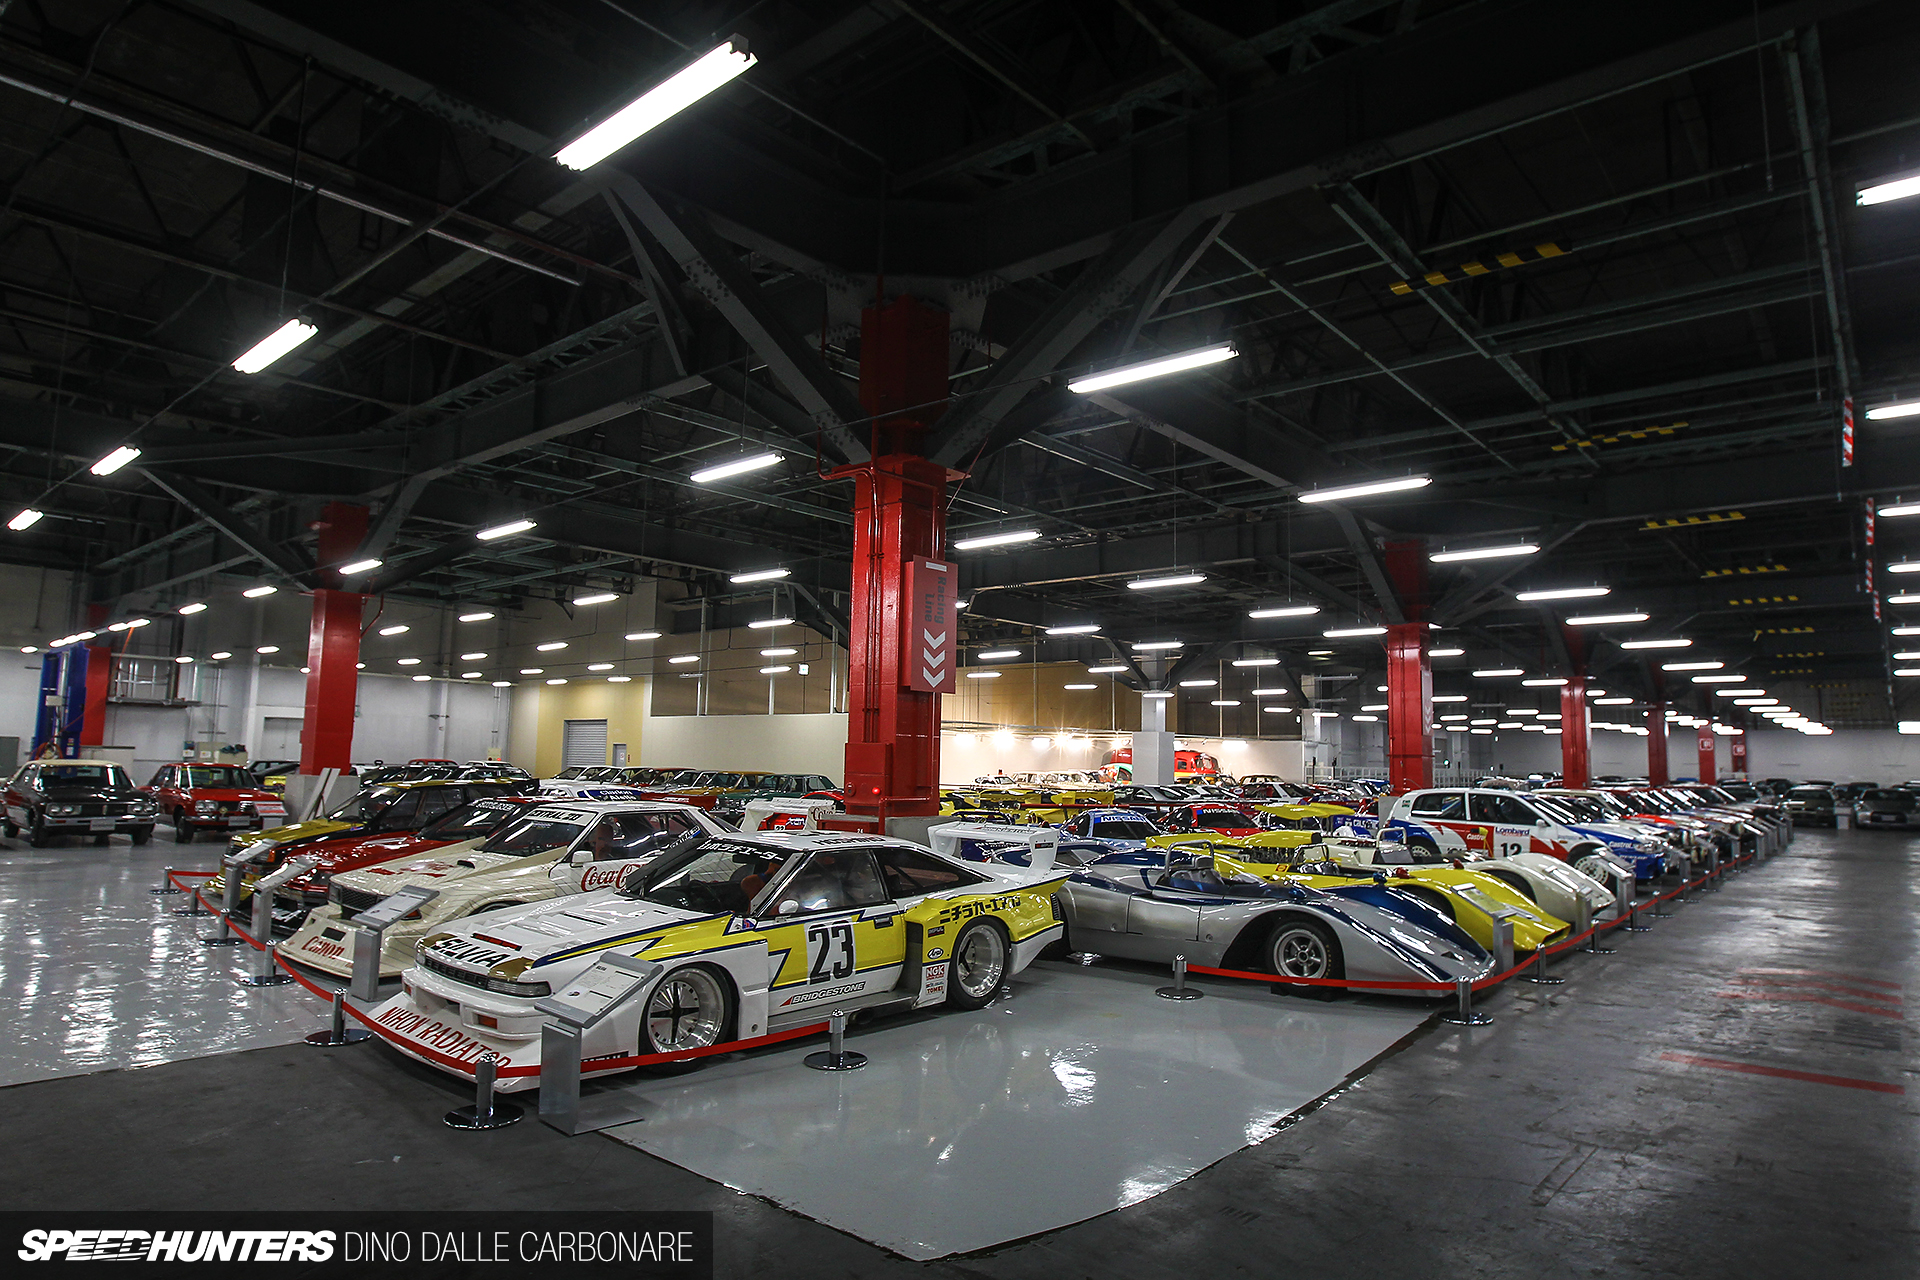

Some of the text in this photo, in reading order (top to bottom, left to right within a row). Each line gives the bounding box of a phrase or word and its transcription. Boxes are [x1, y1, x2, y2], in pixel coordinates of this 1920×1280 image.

[924, 593, 935, 622] Line
[934, 576, 947, 624] Racing
[1495, 826, 1530, 835] Lombard
[1501, 843, 1522, 858] 12
[302, 936, 345, 959] Canon
[430, 938, 510, 968] SILVIA
[809, 920, 854, 985] 23
[926, 966, 944, 978] NGK
[792, 981, 866, 1004] BRIDGESTONE
[375, 1006, 420, 1034] NIHON
